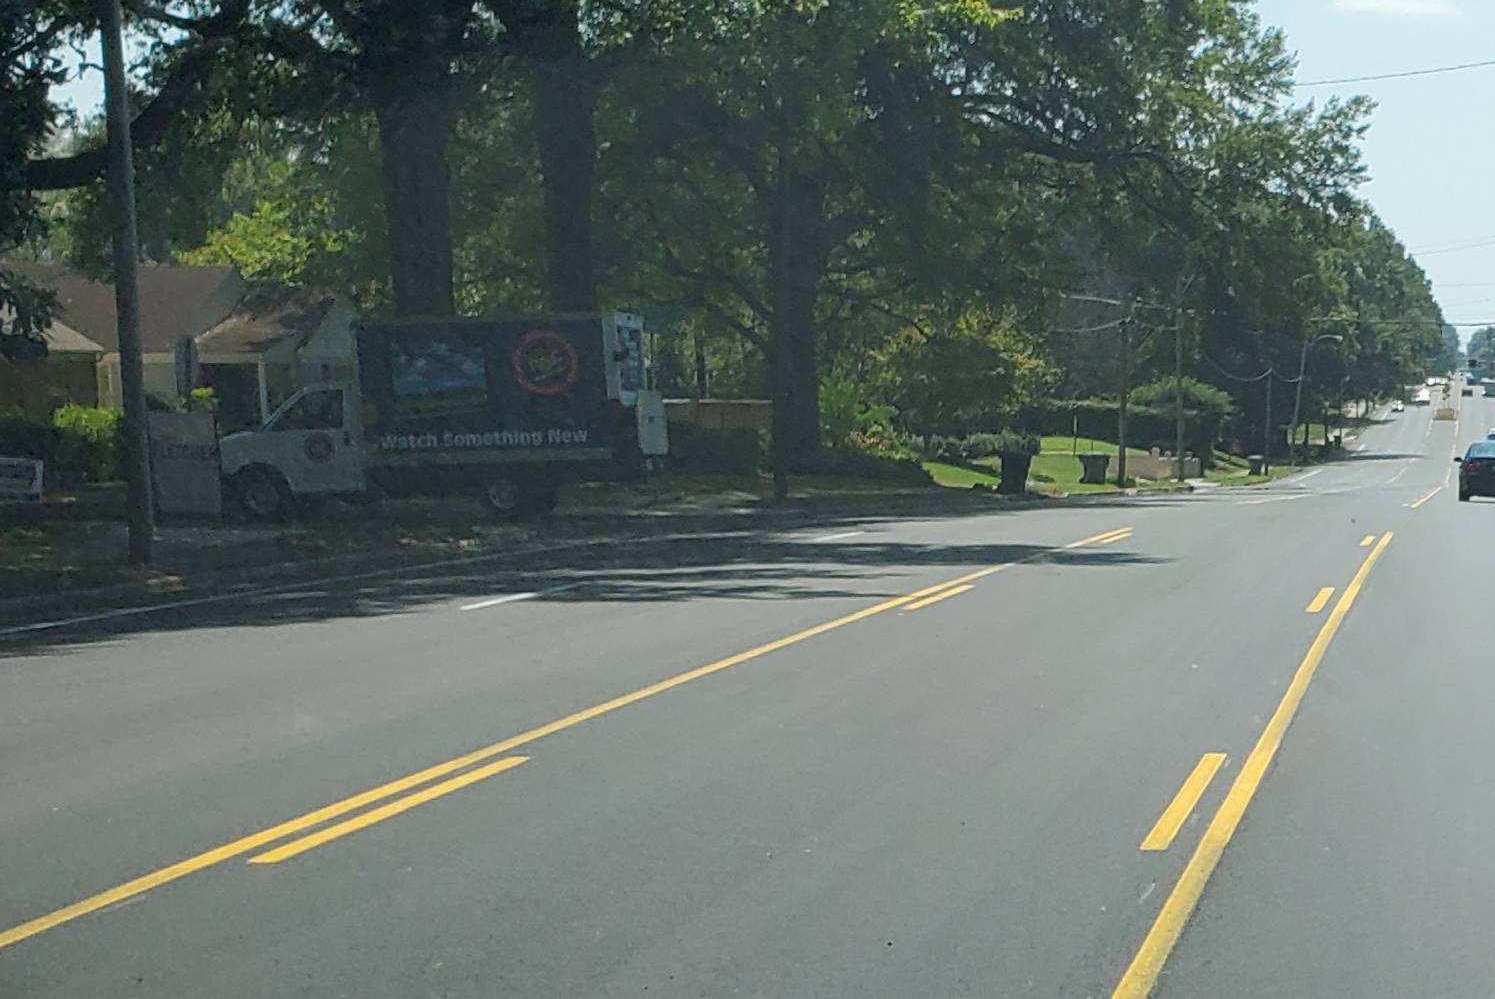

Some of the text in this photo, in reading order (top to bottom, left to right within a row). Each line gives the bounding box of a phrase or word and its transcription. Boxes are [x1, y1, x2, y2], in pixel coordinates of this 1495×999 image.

[381, 428, 588, 449] Watch Something New
